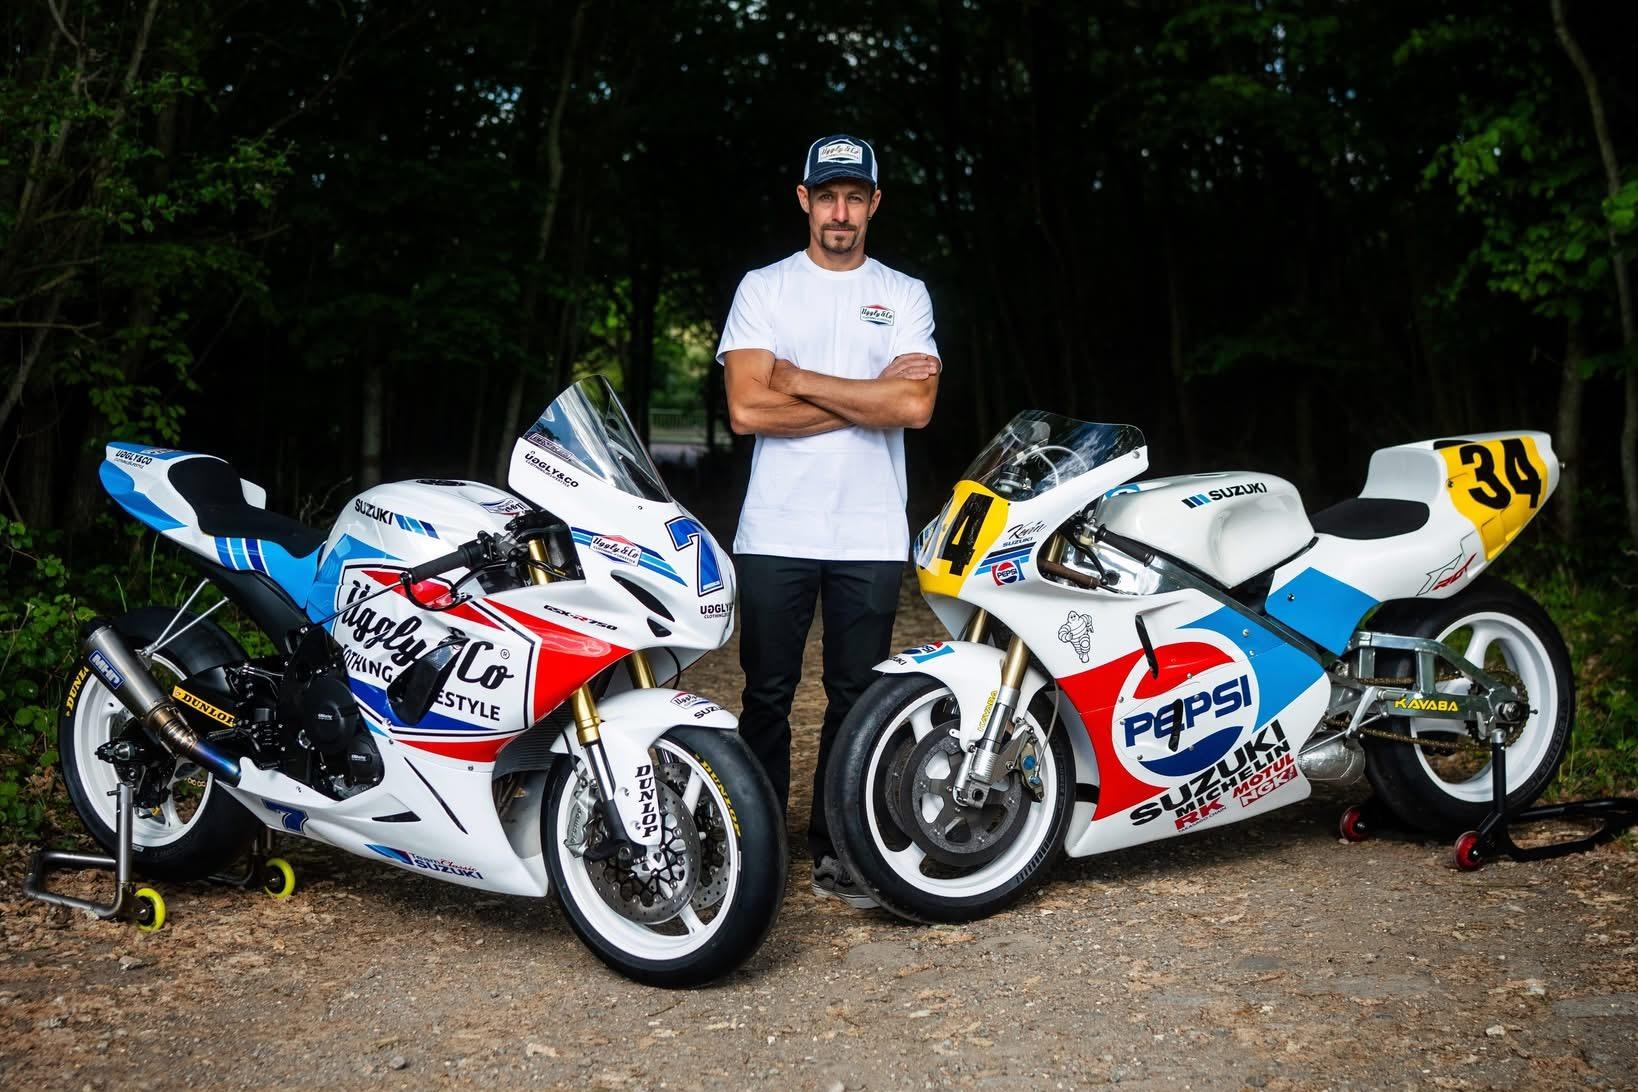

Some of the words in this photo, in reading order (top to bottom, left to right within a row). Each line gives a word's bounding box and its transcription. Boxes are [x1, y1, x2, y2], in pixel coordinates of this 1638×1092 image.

[1208, 482, 1268, 502] SUZUKI
[1459, 438, 1542, 511] 34
[354, 498, 394, 526] SUZUKI
[940, 491, 995, 577] 4
[664, 515, 725, 598] 7
[1002, 536, 1034, 548] SUZUKI
[996, 567, 1018, 579] PEPSI
[66, 665, 90, 711] DUNL
[343, 647, 394, 684] OTHING
[182, 692, 236, 725] DUNLOP
[433, 688, 501, 722] ESTYLE
[1123, 673, 1253, 748] PEPSI
[1129, 718, 1287, 827] SUZUKI
[1174, 739, 1292, 819] MICHELIN
[1174, 797, 1225, 831] RK
[1232, 752, 1295, 799] MOTUL
[1240, 765, 1298, 808] NGK
[635, 764, 658, 838] DUNLOP
[701, 760, 741, 837] DUNLOP
[414, 859, 484, 880] SUZUKI
